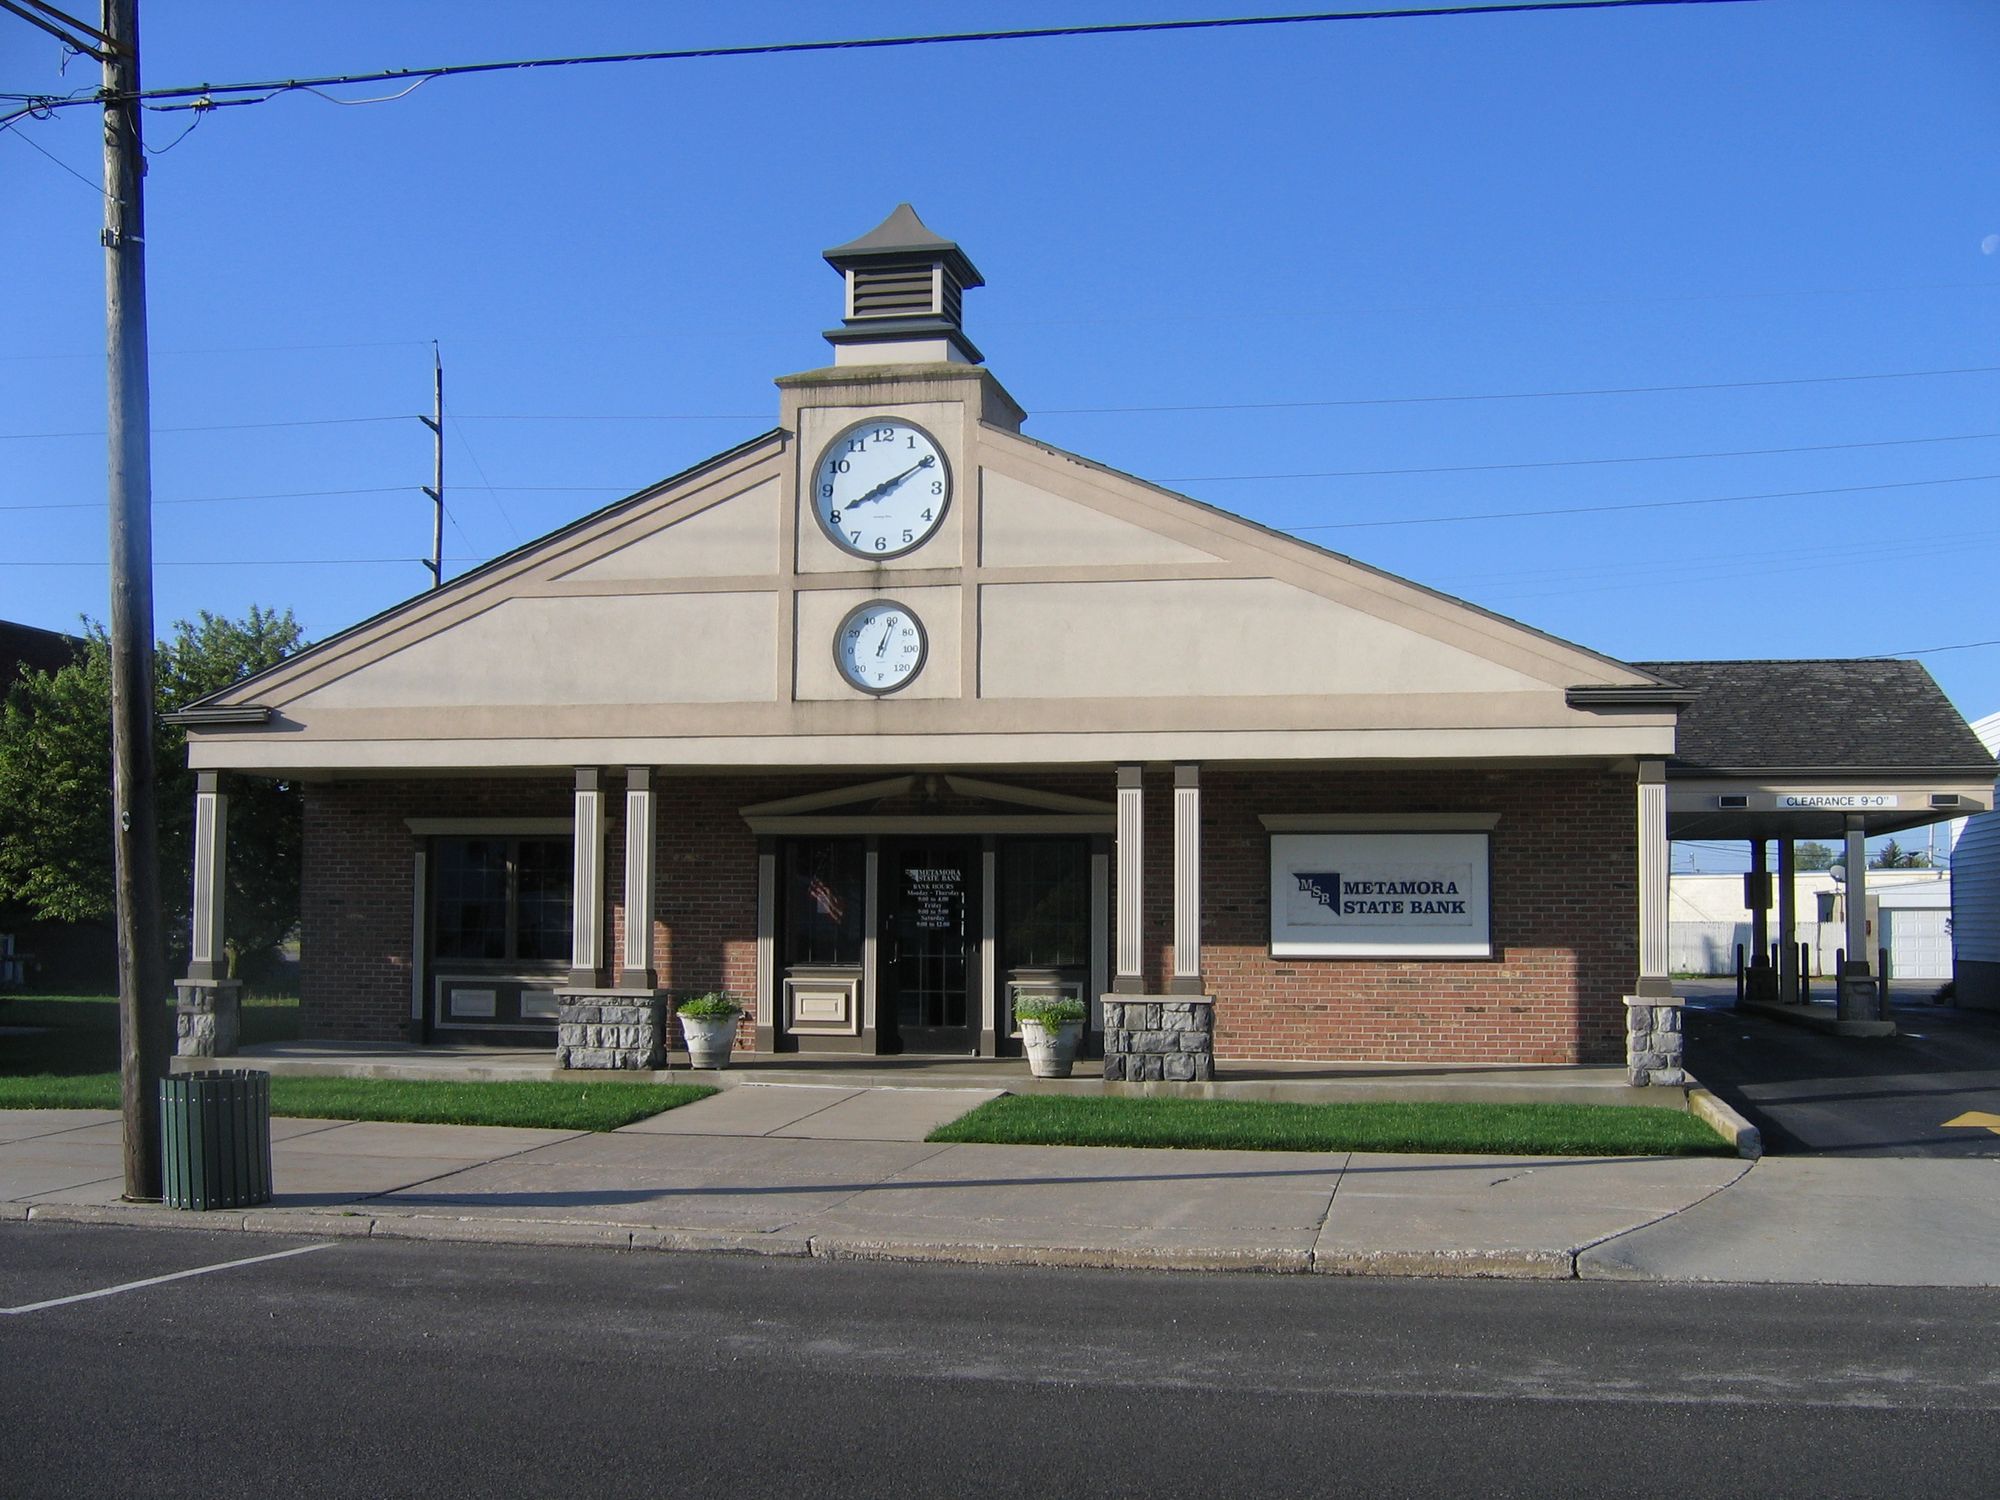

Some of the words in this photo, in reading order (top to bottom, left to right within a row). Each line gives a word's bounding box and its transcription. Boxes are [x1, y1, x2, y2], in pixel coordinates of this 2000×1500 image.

[873, 428, 895, 442] 12
[847, 440, 867, 453] 11
[907, 436, 916, 449] 1
[829, 460, 850, 474] 10
[822, 484, 833, 498] 9
[931, 481, 942, 495] 3
[830, 510, 841, 524] 8
[921, 508, 932, 522] 4
[850, 531, 862, 544] 7
[902, 530, 913, 543] 5
[875, 537, 886, 551] 6
[864, 617, 876, 625] 40
[886, 616, 898, 625] 60
[848, 630, 860, 638] 20
[902, 628, 914, 637] 80
[848, 647, 854, 655] 0
[903, 645, 919, 653] 100
[894, 664, 911, 672] 120
[877, 673, 884, 681] F
[1786, 796, 1855, 807] CLEARANCE
[1343, 881, 1459, 895] METAMORA
[1343, 901, 1404, 914] STATE
[1410, 901, 1466, 914] BANK
